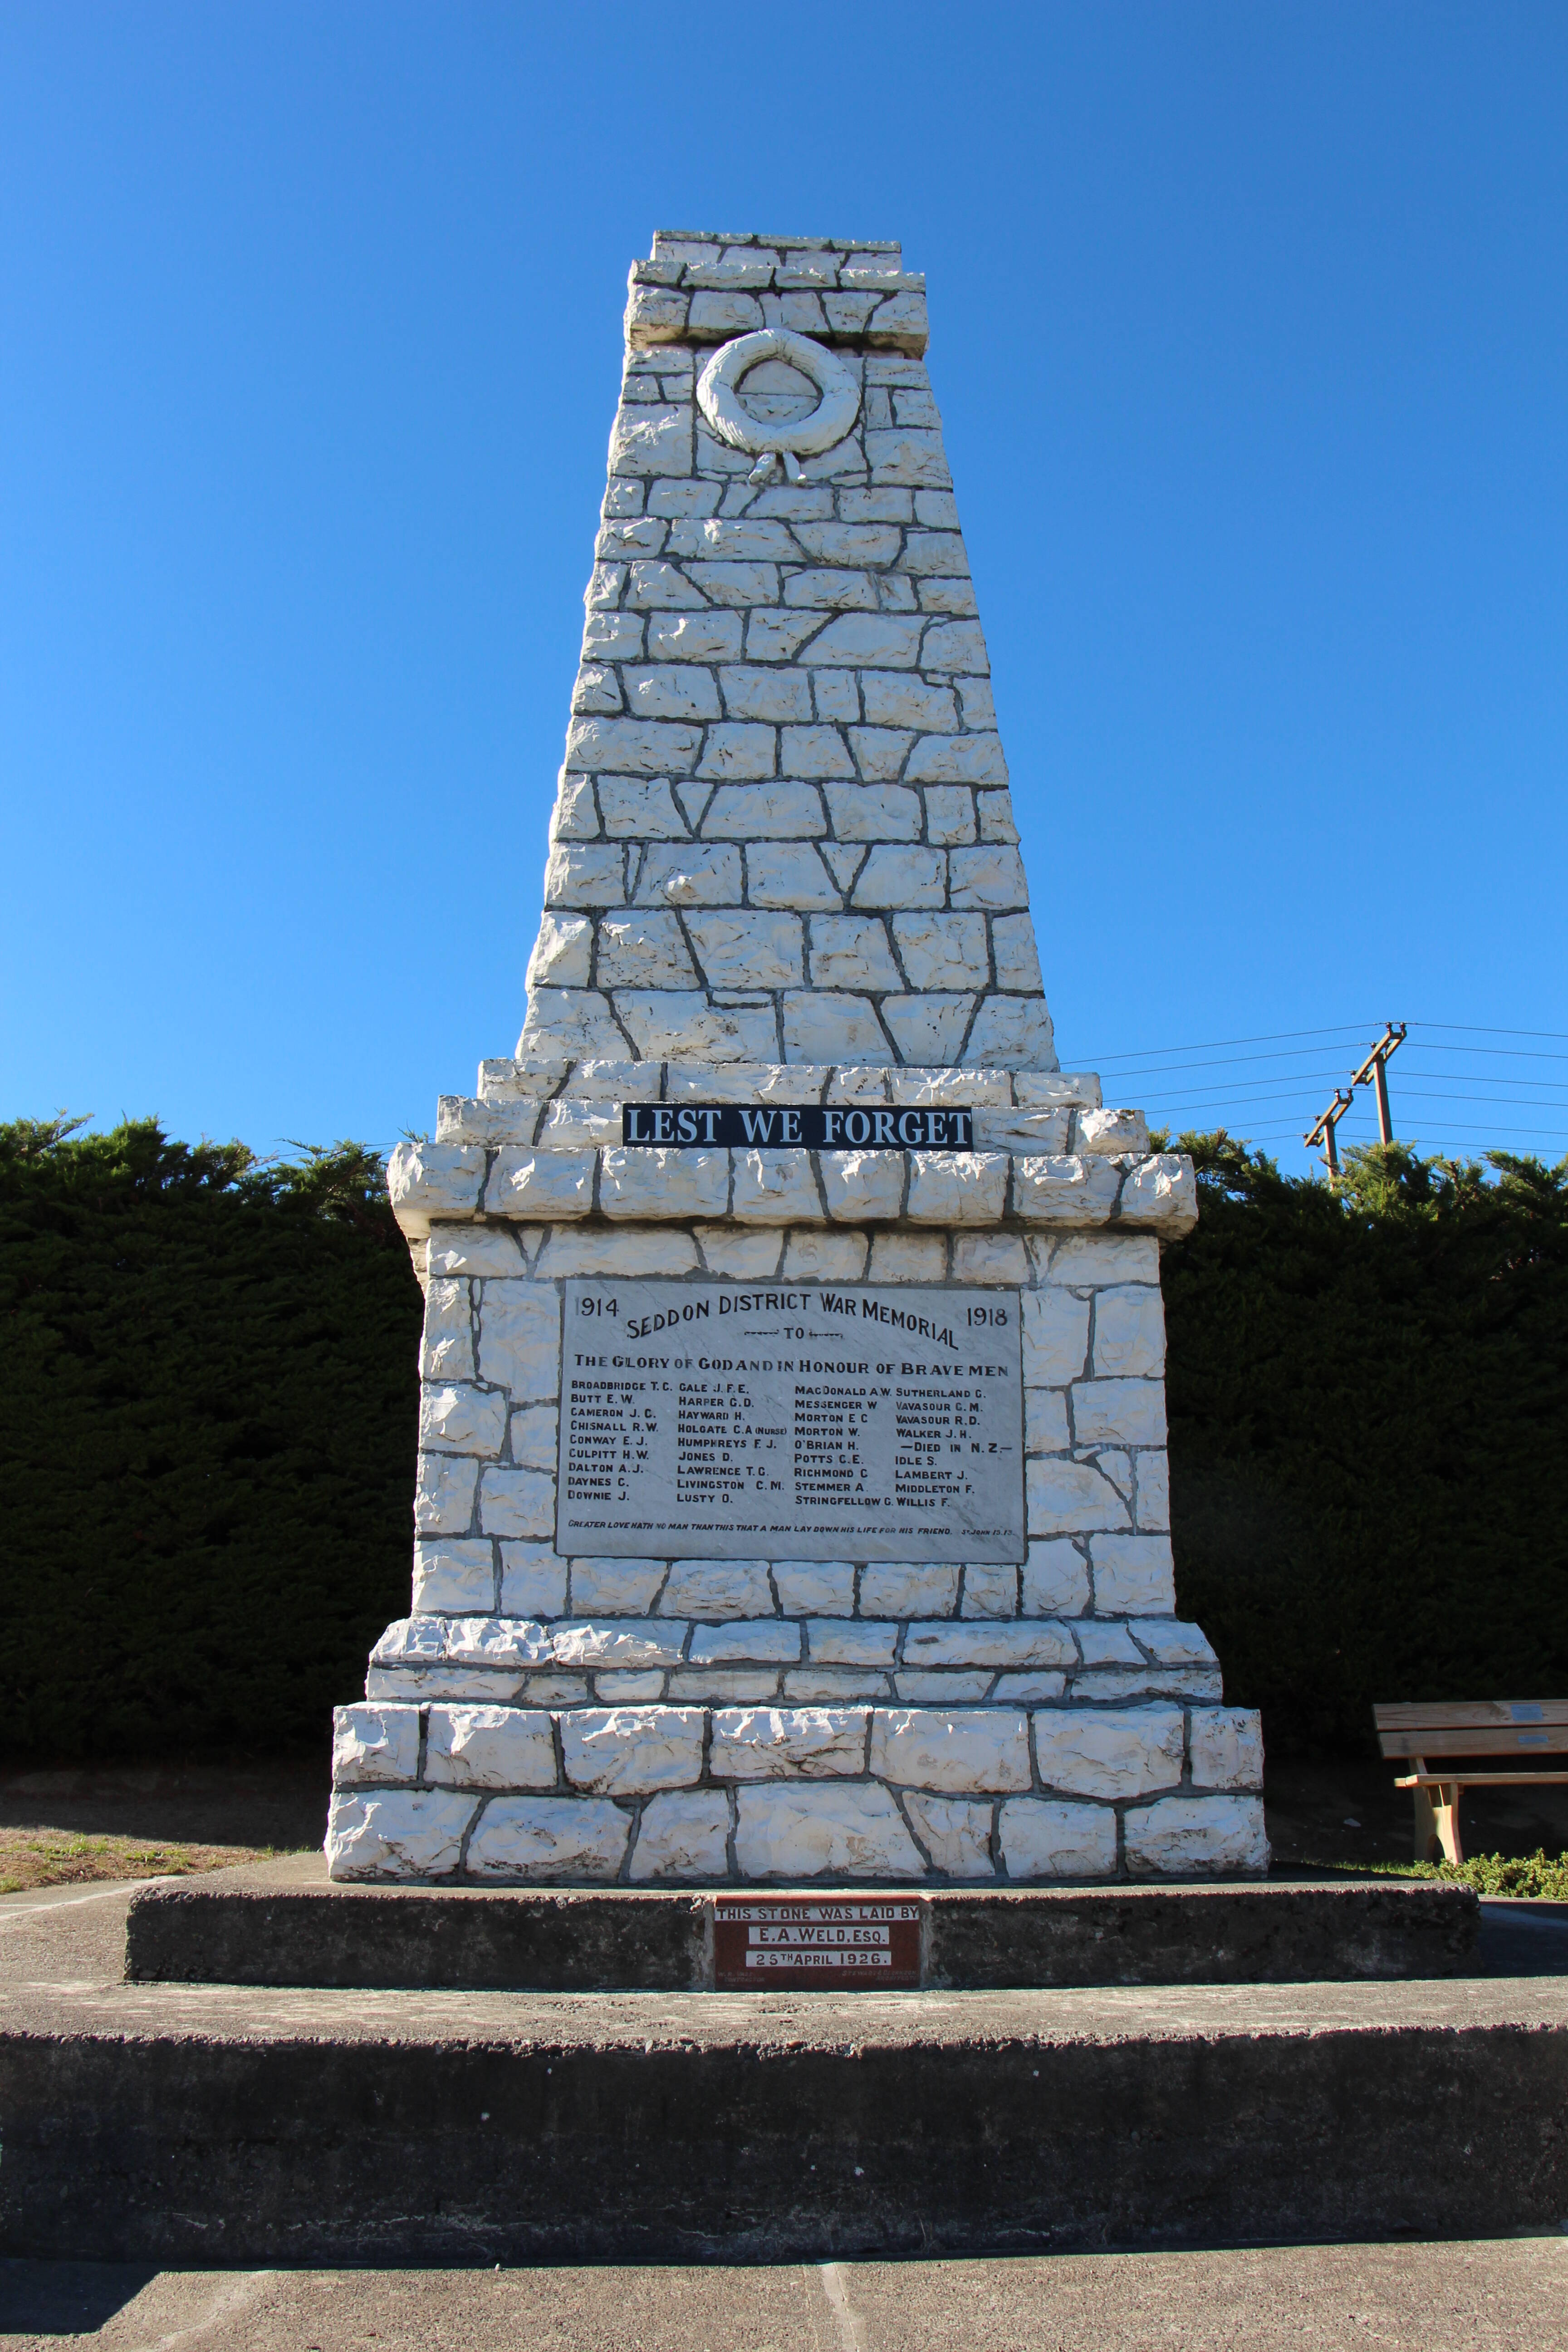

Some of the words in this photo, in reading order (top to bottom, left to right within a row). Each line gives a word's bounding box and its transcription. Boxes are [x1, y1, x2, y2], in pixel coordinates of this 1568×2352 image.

[627, 1110, 721, 1143] LEST
[739, 1110, 802, 1143] WE
[823, 1110, 971, 1143] FORGET
[575, 1297, 618, 1316] 1914
[627, 1300, 709, 1338] SEDDON
[720, 1294, 811, 1314] DISTRICT
[820, 1293, 856, 1316] WAR
[863, 1299, 958, 1350] MEMORIAL
[968, 1308, 1007, 1326] 1918
[784, 1328, 804, 1339] TO
[575, 1355, 607, 1366] THE
[612, 1356, 669, 1368] GLORY
[675, 1359, 692, 1368] OF
[699, 1358, 732, 1370] GOD
[735, 1361, 773, 1371] AND
[778, 1361, 793, 1371] IN
[800, 1360, 869, 1373] HONOUR
[877, 1363, 895, 1374] OF
[902, 1363, 963, 1376] BRAVE
[969, 1366, 1008, 1376] MEN
[572, 1381, 645, 1390] BROADBRIDGE
[680, 1383, 707, 1392] GALE
[897, 1388, 970, 1397] SUTHERLAND
[571, 1394, 601, 1403] BUTT
[679, 1396, 724, 1406] HARPER
[795, 1400, 862, 1409] MESSENGER
[897, 1402, 951, 1411] VAVASOUR
[571, 1408, 622, 1417] CAMERON
[679, 1411, 728, 1420] HAYWARD
[735, 1412, 744, 1420] H.
[795, 1413, 843, 1422] MORTON
[896, 1415, 950, 1424] VAVASOUR
[571, 1421, 626, 1431] CHISNALL
[678, 1424, 727, 1433] HOLGATE
[795, 1427, 843, 1436] MORTON
[897, 1429, 941, 1438] WALKER
[570, 1435, 616, 1444] CONWAY
[678, 1438, 746, 1448] HUMPHREYS
[795, 1441, 842, 1449] O'BRIAN
[569, 1449, 617, 1458] CULPITT
[679, 1452, 715, 1461] JONES
[723, 1453, 732, 1461] D.
[795, 1454, 832, 1463] POTTS
[896, 1456, 922, 1465] IDLE
[927, 1456, 936, 1465] S.
[569, 1463, 612, 1472] DALTON
[678, 1465, 740, 1475] LAWRENCE
[794, 1468, 853, 1477] RICHMOND
[896, 1470, 952, 1479] LAMBERT
[957, 1471, 967, 1480] J.
[568, 1477, 611, 1486] DAYNES
[678, 1480, 744, 1489] LIVINGSTON
[795, 1482, 850, 1491] STEMMER
[896, 1484, 959, 1493] MIDDLETON
[966, 1485, 974, 1493] F.
[568, 1490, 611, 1500] DOWNIE
[618, 1492, 629, 1500] J.
[677, 1494, 715, 1502] LUSTY
[795, 1496, 881, 1505] STRINGFELLOW
[897, 1498, 935, 1506] WILLIS
[941, 1498, 950, 1507] F.
[715, 1906, 752, 1919] THIS
[757, 1906, 812, 1919] STONE
[818, 1906, 853, 1919] WAS
[858, 1906, 896, 1919] LAID
[902, 1906, 919, 1918] BY
[794, 1954, 833, 1965] APRIL
